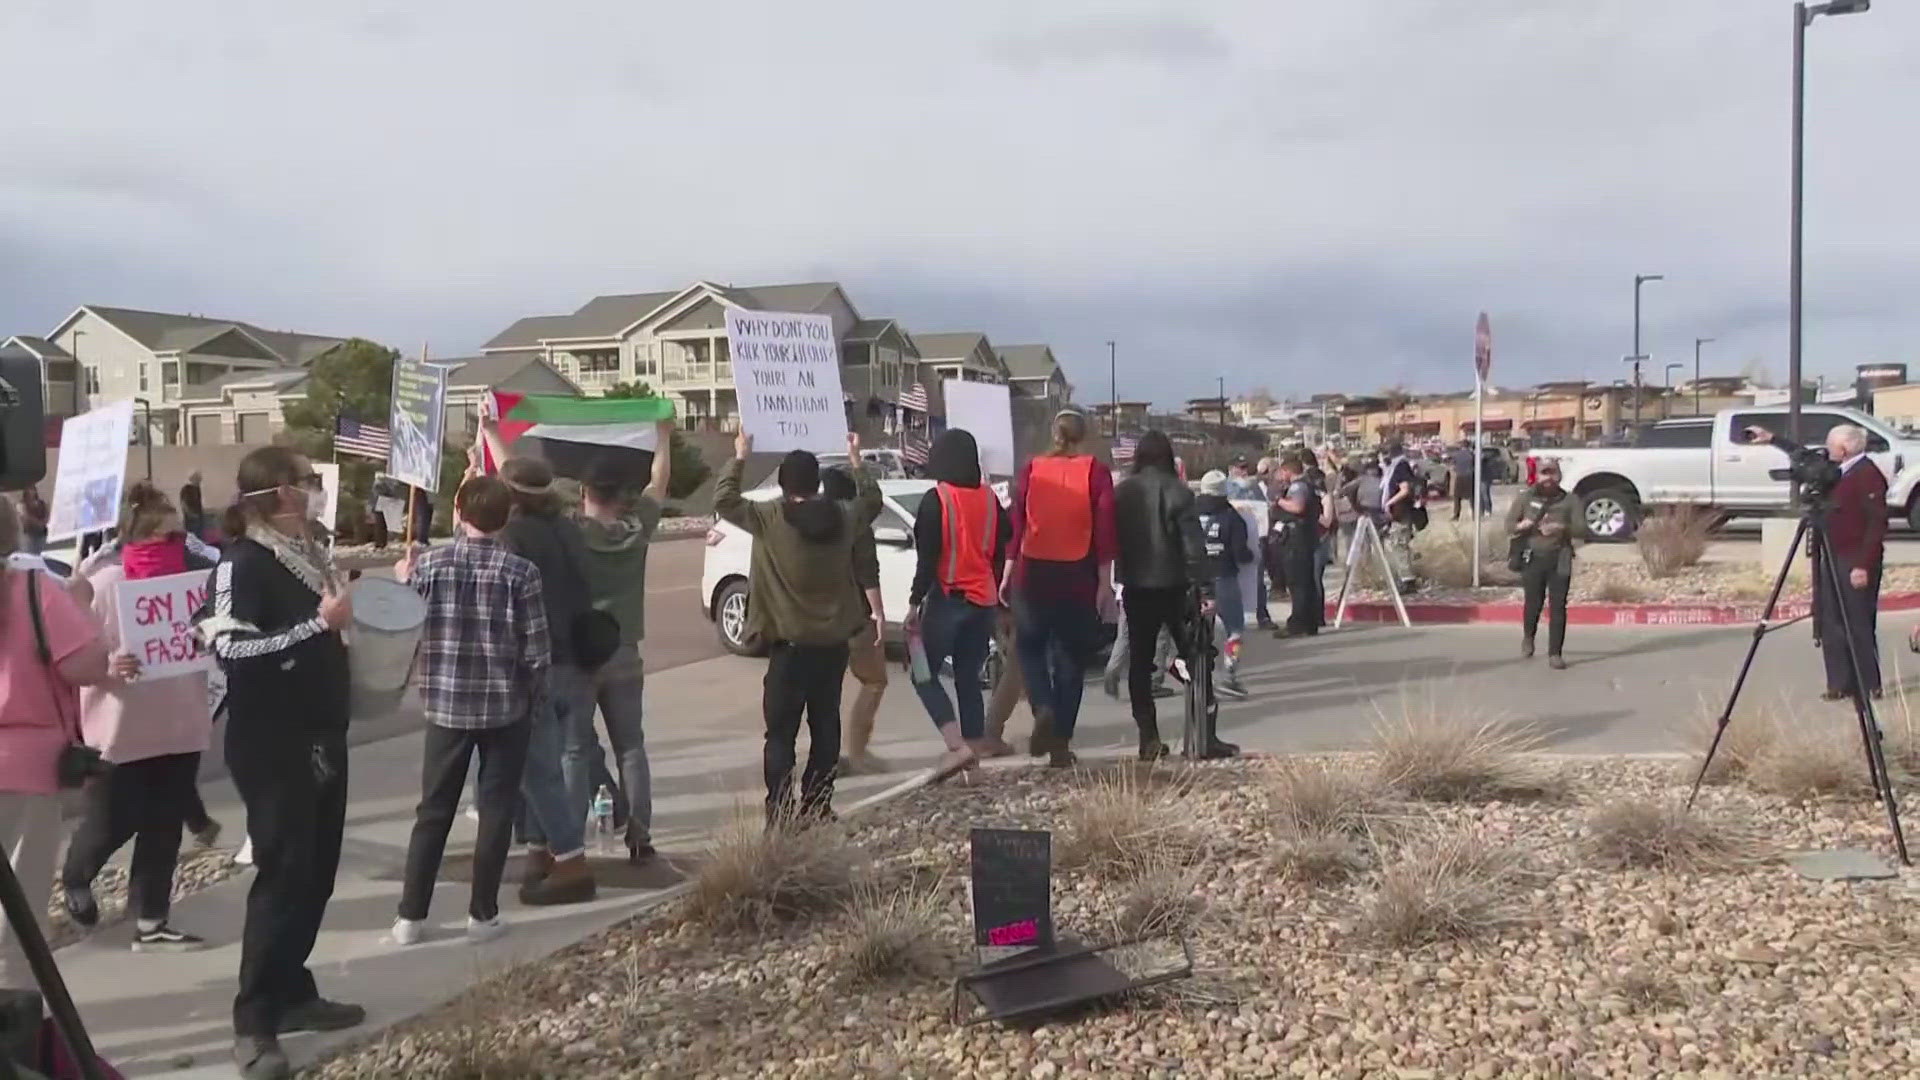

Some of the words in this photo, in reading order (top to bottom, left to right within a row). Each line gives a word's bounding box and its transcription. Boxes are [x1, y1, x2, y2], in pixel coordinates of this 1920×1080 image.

[735, 318, 768, 337] WHY
[804, 322, 829, 340] YOU
[797, 370, 815, 388] AN
[776, 420, 809, 437] TOO
[135, 592, 173, 625] SAY
[171, 620, 187, 634] TO
